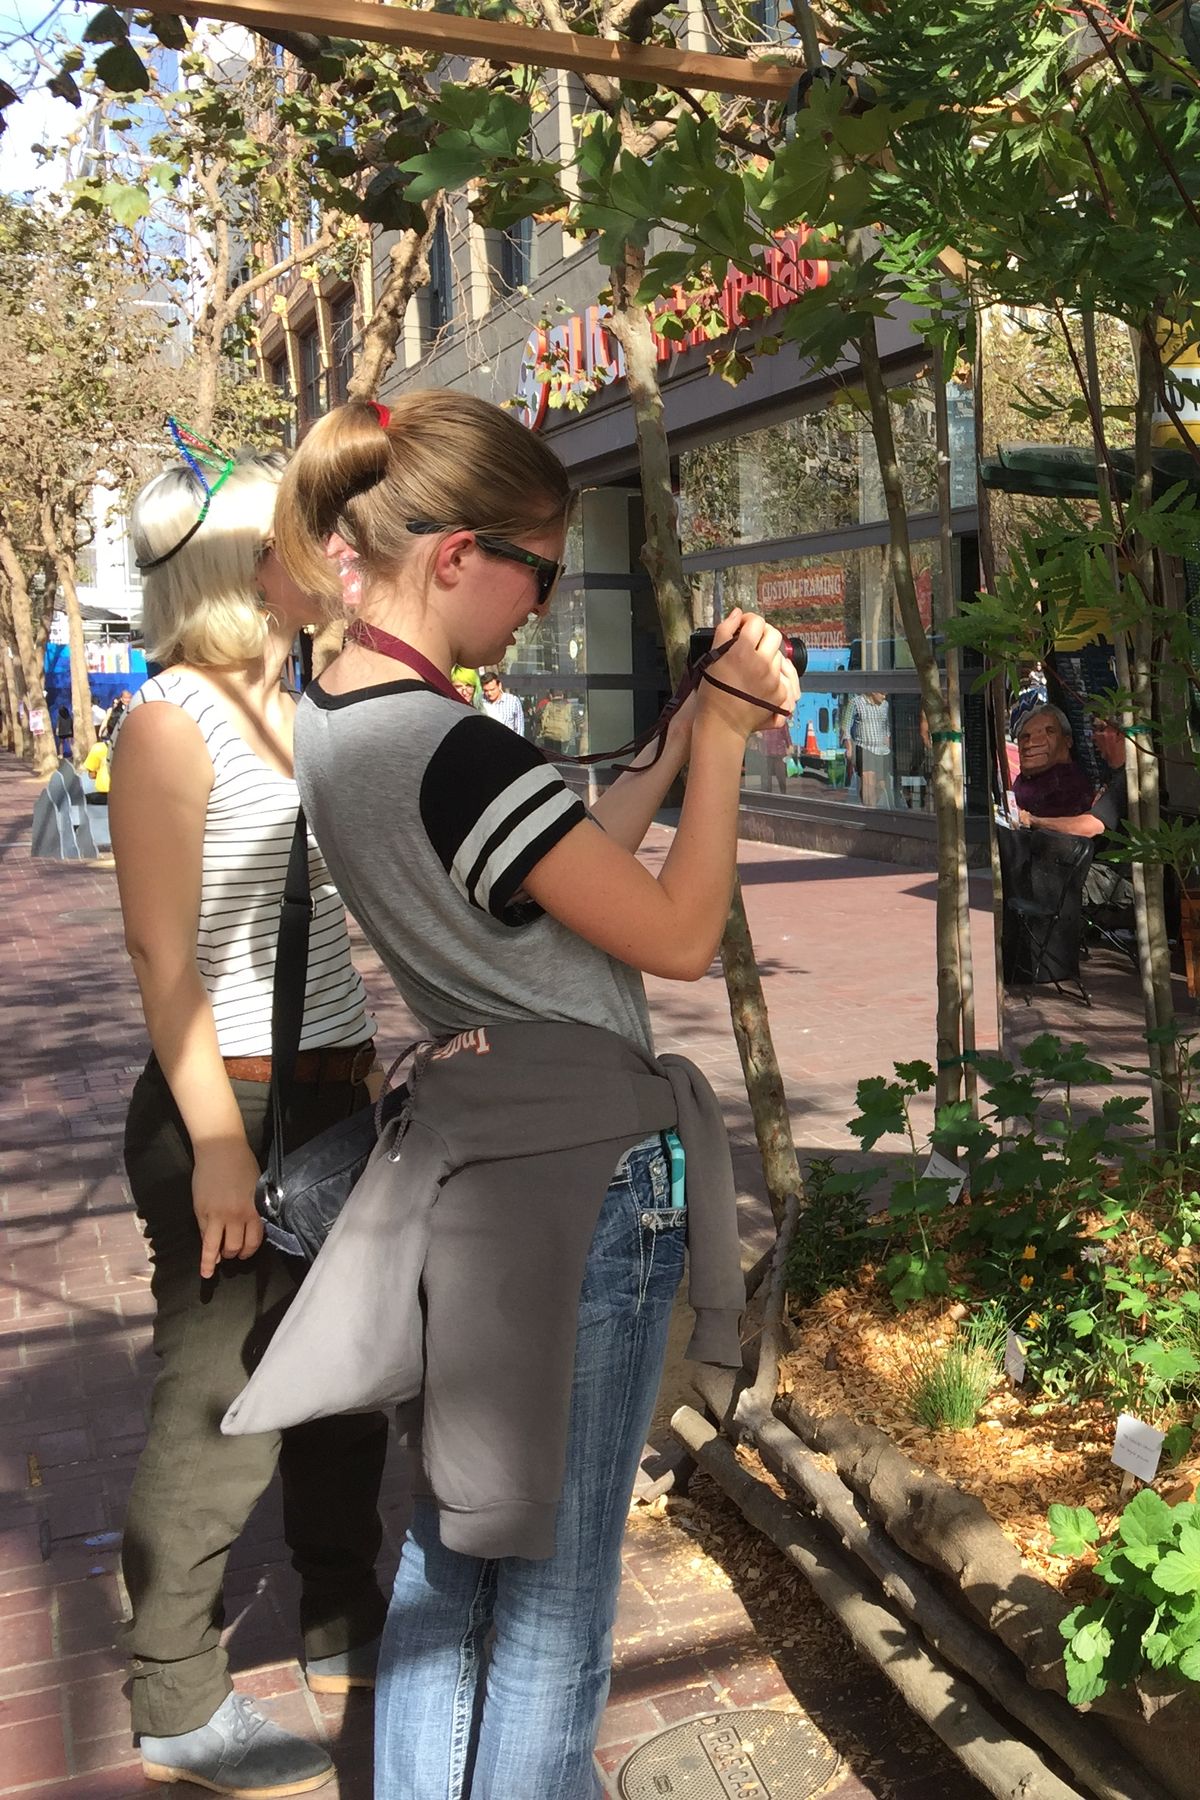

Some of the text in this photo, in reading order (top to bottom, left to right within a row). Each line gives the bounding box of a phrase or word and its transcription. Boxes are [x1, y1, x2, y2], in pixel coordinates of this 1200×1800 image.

[762, 574, 841, 600] CUSTOM FRAMING
[800, 631, 843, 649] PRINTING
